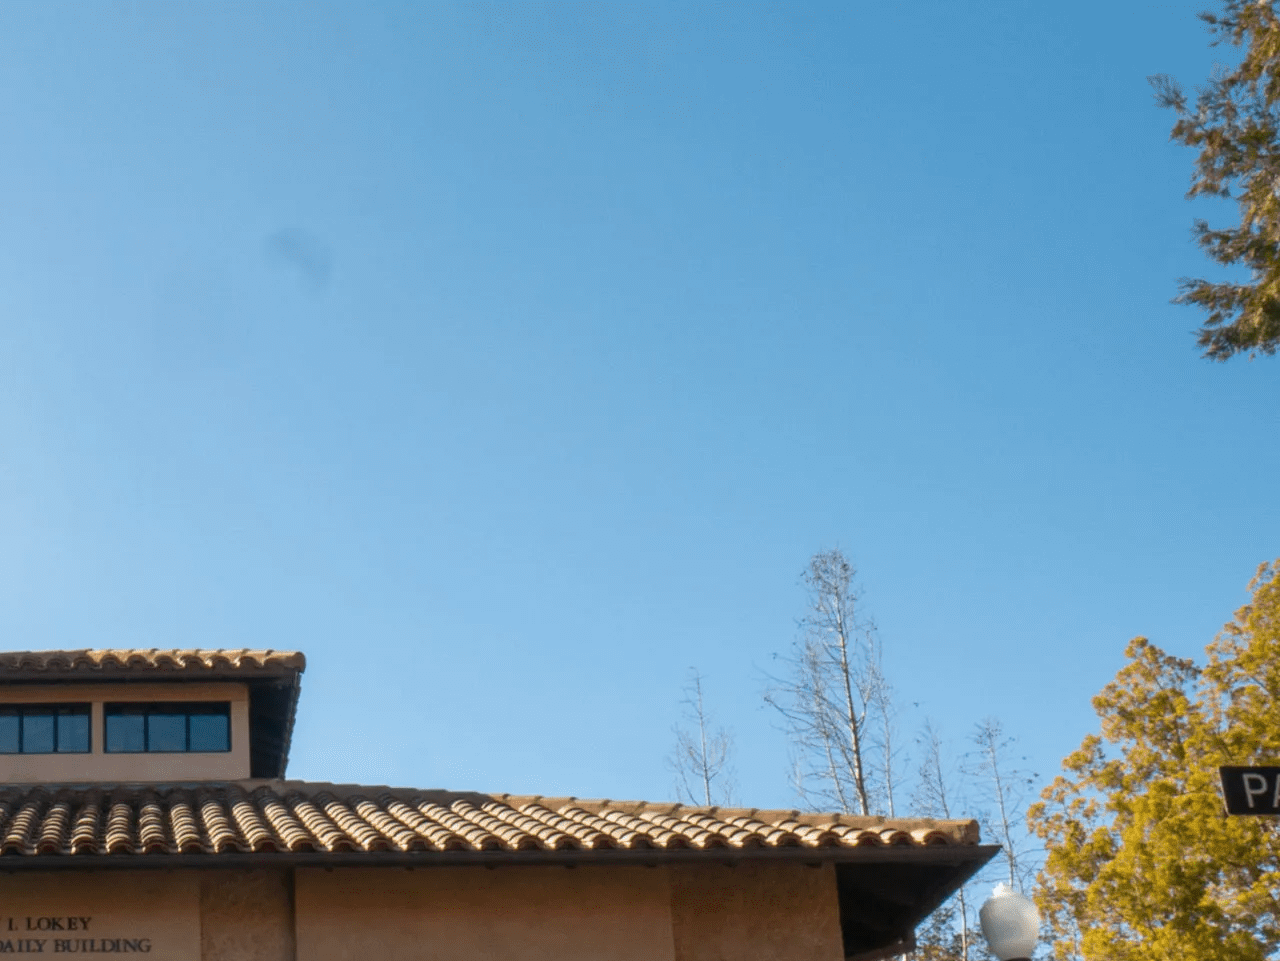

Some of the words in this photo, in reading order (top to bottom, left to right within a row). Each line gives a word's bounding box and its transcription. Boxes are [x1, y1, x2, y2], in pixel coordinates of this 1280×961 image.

[7, 917, 19, 931] I.
[25, 916, 92, 931] LOKEY
[55, 938, 152, 953] BUILDING
